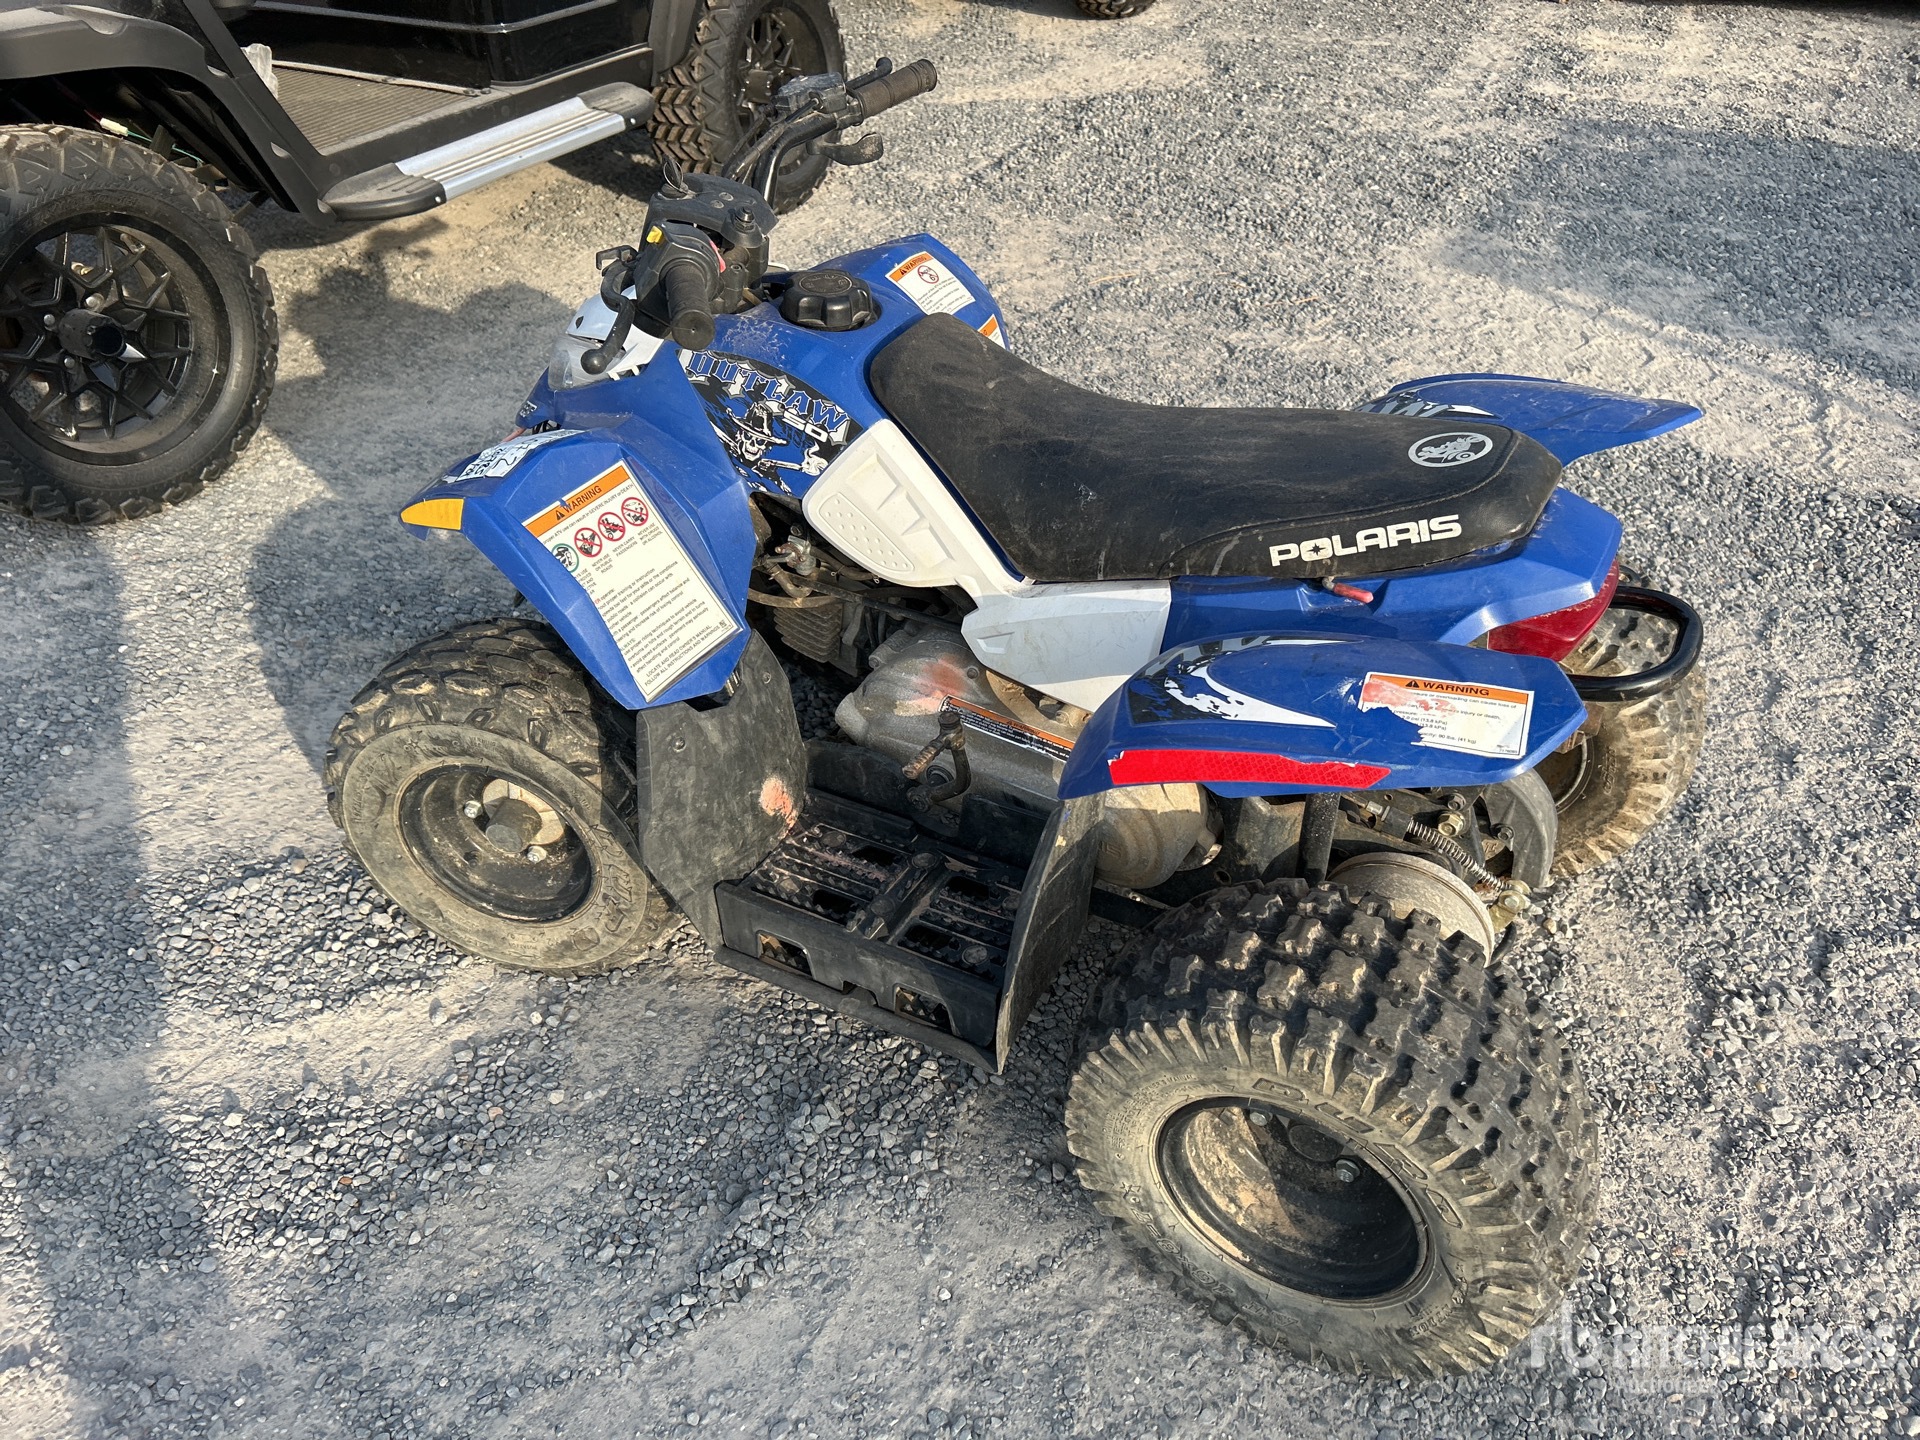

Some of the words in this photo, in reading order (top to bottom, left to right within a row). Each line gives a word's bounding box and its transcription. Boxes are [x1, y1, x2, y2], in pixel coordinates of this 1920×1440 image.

[686, 351, 850, 432] OUTLAW
[782, 409, 829, 443] 50
[563, 485, 602, 515] WARNING
[588, 502, 603, 514] SEVERE
[603, 494, 617, 504] INJURY
[620, 483, 633, 493] DEATH
[1269, 514, 1462, 566] POLARIS
[644, 672, 660, 686] FOLLOW
[659, 665, 668, 674] ALL
[666, 645, 693, 668] INSTRUCTIONS
[692, 638, 701, 647] AND
[645, 663, 661, 677] LOCATE
[660, 656, 669, 665] AND
[668, 648, 680, 658] READ
[1423, 682, 1490, 696] WARNING
